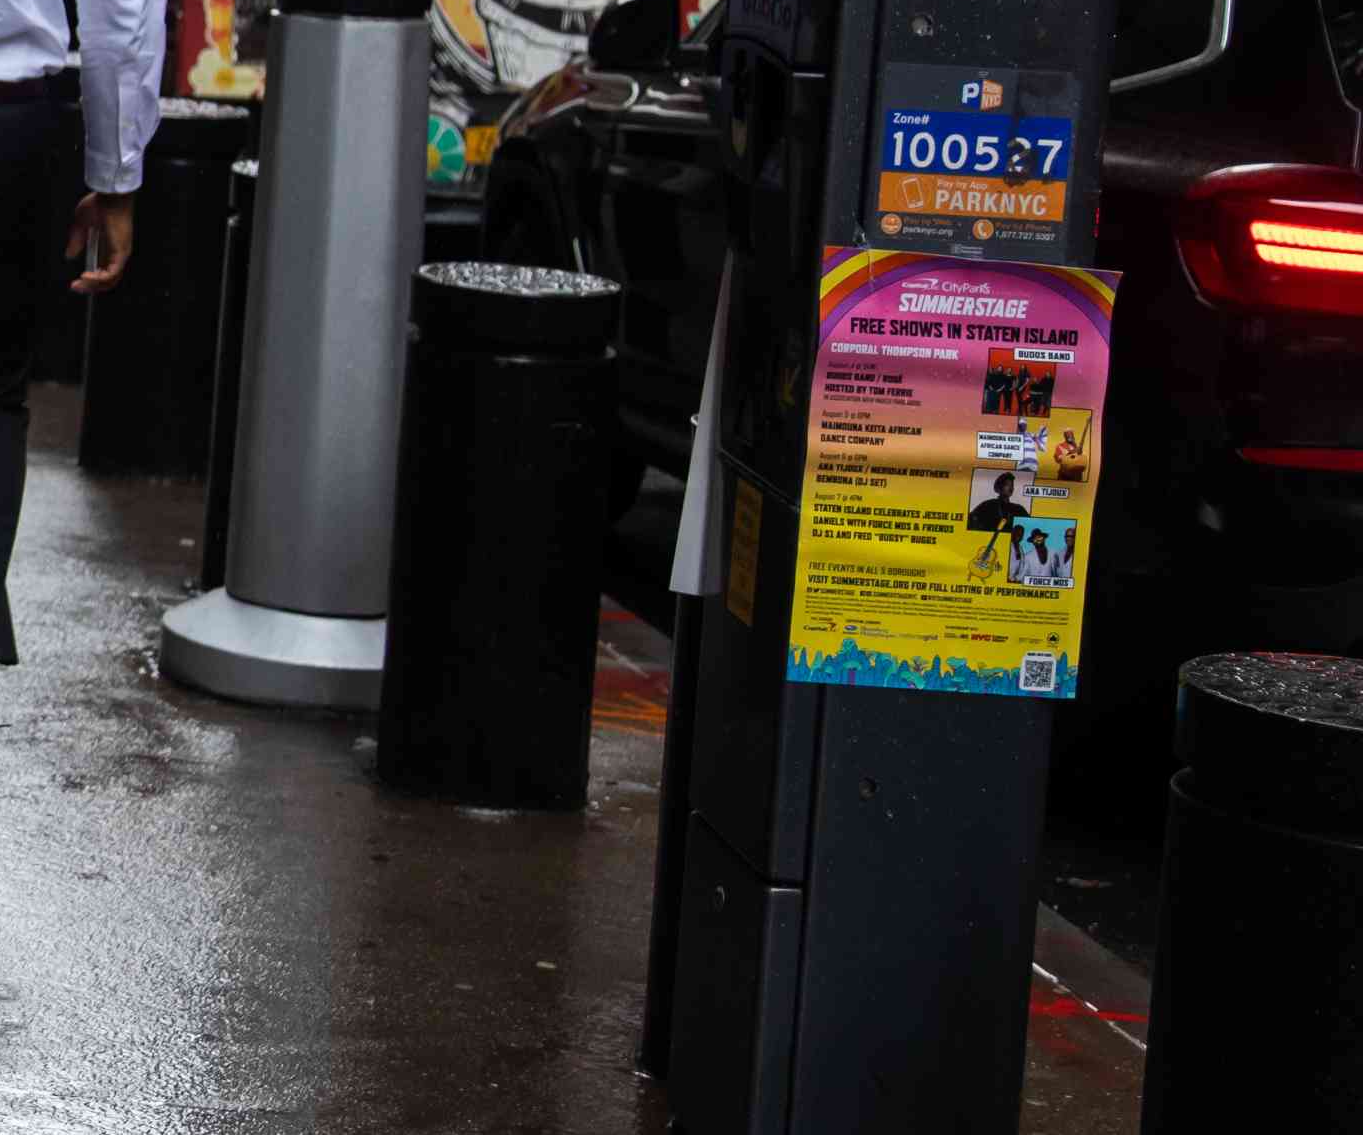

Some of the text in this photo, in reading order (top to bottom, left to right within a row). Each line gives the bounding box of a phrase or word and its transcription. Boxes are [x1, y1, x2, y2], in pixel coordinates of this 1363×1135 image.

[893, 113, 930, 125] Zone#
[935, 190, 1048, 216] PARKNYC
[899, 293, 1028, 319] SUMMERSTAGE
[851, 317, 1078, 346] FREE SHOWS IN STATEN ISLAND
[831, 342, 958, 360] CORPORAL THOMPSON PARK
[1018, 350, 1071, 361] BUDOS BAND
[825, 383, 854, 393] HOSTED
[857, 386, 868, 394] BY
[869, 386, 885, 395] TOM
[821, 421, 922, 435] MAIMOUNA KEITA AFRICAN
[820, 435, 885, 446] DANCE COMPANY
[818, 463, 833, 471] ANA
[909, 468, 950, 478] BROTHERS
[1025, 487, 1067, 497] ANA TIJOUX
[814, 504, 964, 521] STATEN ISLAND CELEBRATES JESSIE LEE
[813, 516, 845, 525] DANIELS
[847, 518, 866, 527] WITH
[868, 519, 892, 529] FORCE
[922, 523, 954, 533] FRIENDS
[812, 529, 822, 537] DJ
[836, 530, 852, 539] AND
[853, 531, 872, 540] FRED
[828, 563, 855, 573] EVENTS
[856, 565, 864, 573] IN
[865, 566, 878, 575] ALL
[887, 567, 927, 577] BOROUGHS
[808, 575, 1060, 599] VISIT SUMMERSTAGE.ORG FOR FULL LISTING OF PERFORMANCES
